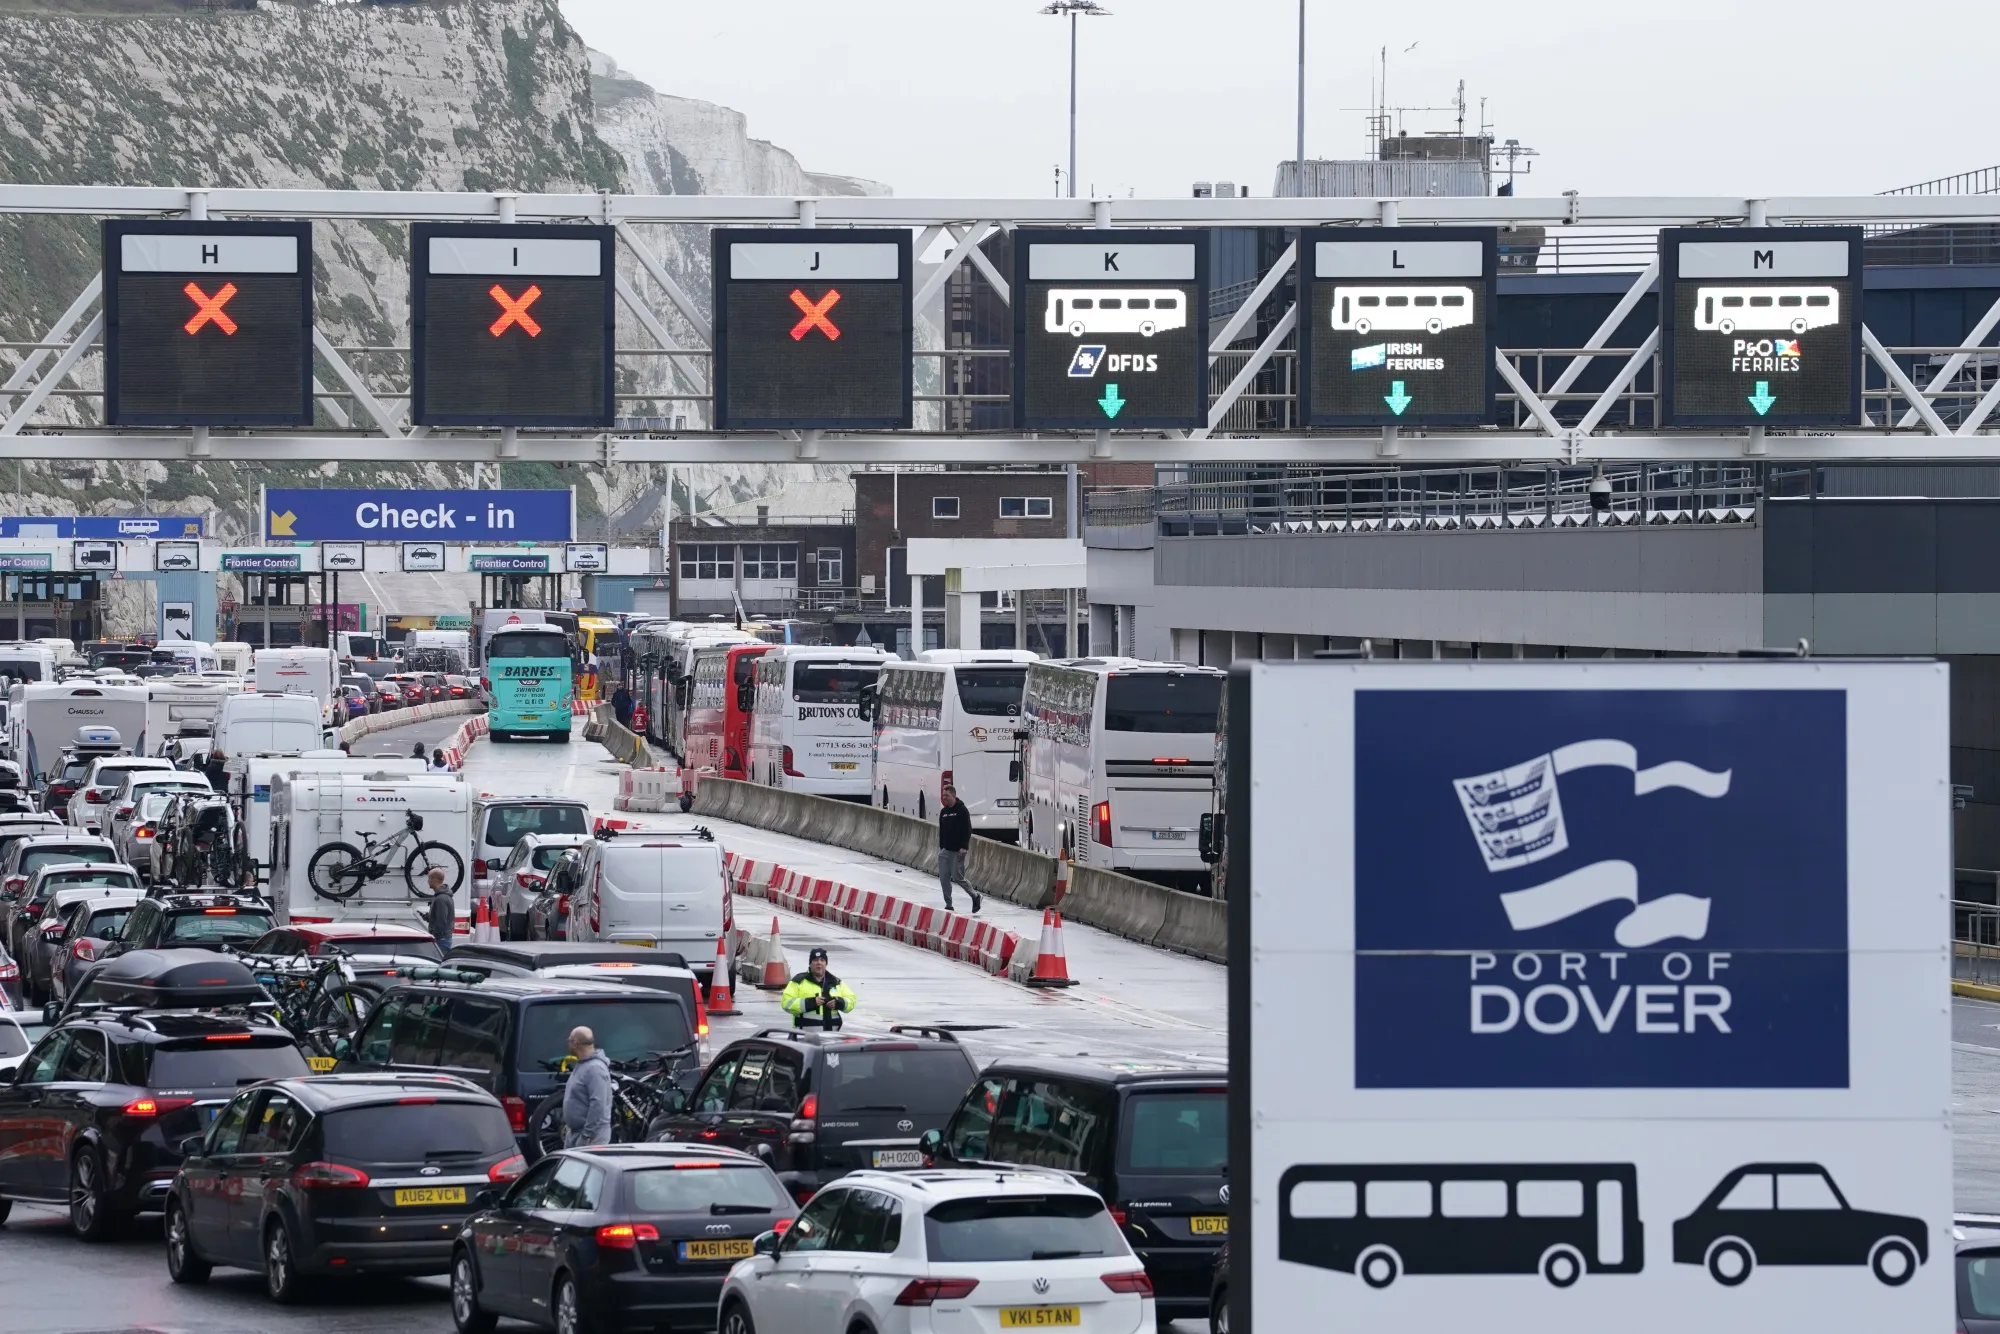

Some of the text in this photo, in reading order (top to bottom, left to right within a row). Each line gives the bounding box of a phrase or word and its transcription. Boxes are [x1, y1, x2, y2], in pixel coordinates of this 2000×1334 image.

[202, 244, 218, 264] H
[512, 247, 518, 266] I
[810, 252, 819, 272] J
[1104, 252, 1120, 272] K
[1392, 250, 1405, 268] L
[1754, 250, 1774, 268] M
[1386, 343, 1422, 354] IRISH
[1734, 340, 1774, 356] P&O
[1108, 354, 1158, 372] DFDS
[1386, 358, 1444, 370] FERRIES
[1732, 357, 1800, 372] FERRIES
[356, 502, 456, 528] Check
[488, 502, 514, 528] in
[15, 558, 48, 566] Control
[226, 558, 298, 567] Frontier Control
[475, 559, 546, 568] Frontier Control
[505, 666, 555, 677] BARNES
[798, 706, 860, 720] BRUTON'S CO
[1470, 952, 1732, 981] PORT OF
[1470, 984, 1732, 1034] DOVER
[402, 1189, 460, 1202] AU62 VCW
[691, 1242, 749, 1255] MA61 HSG
